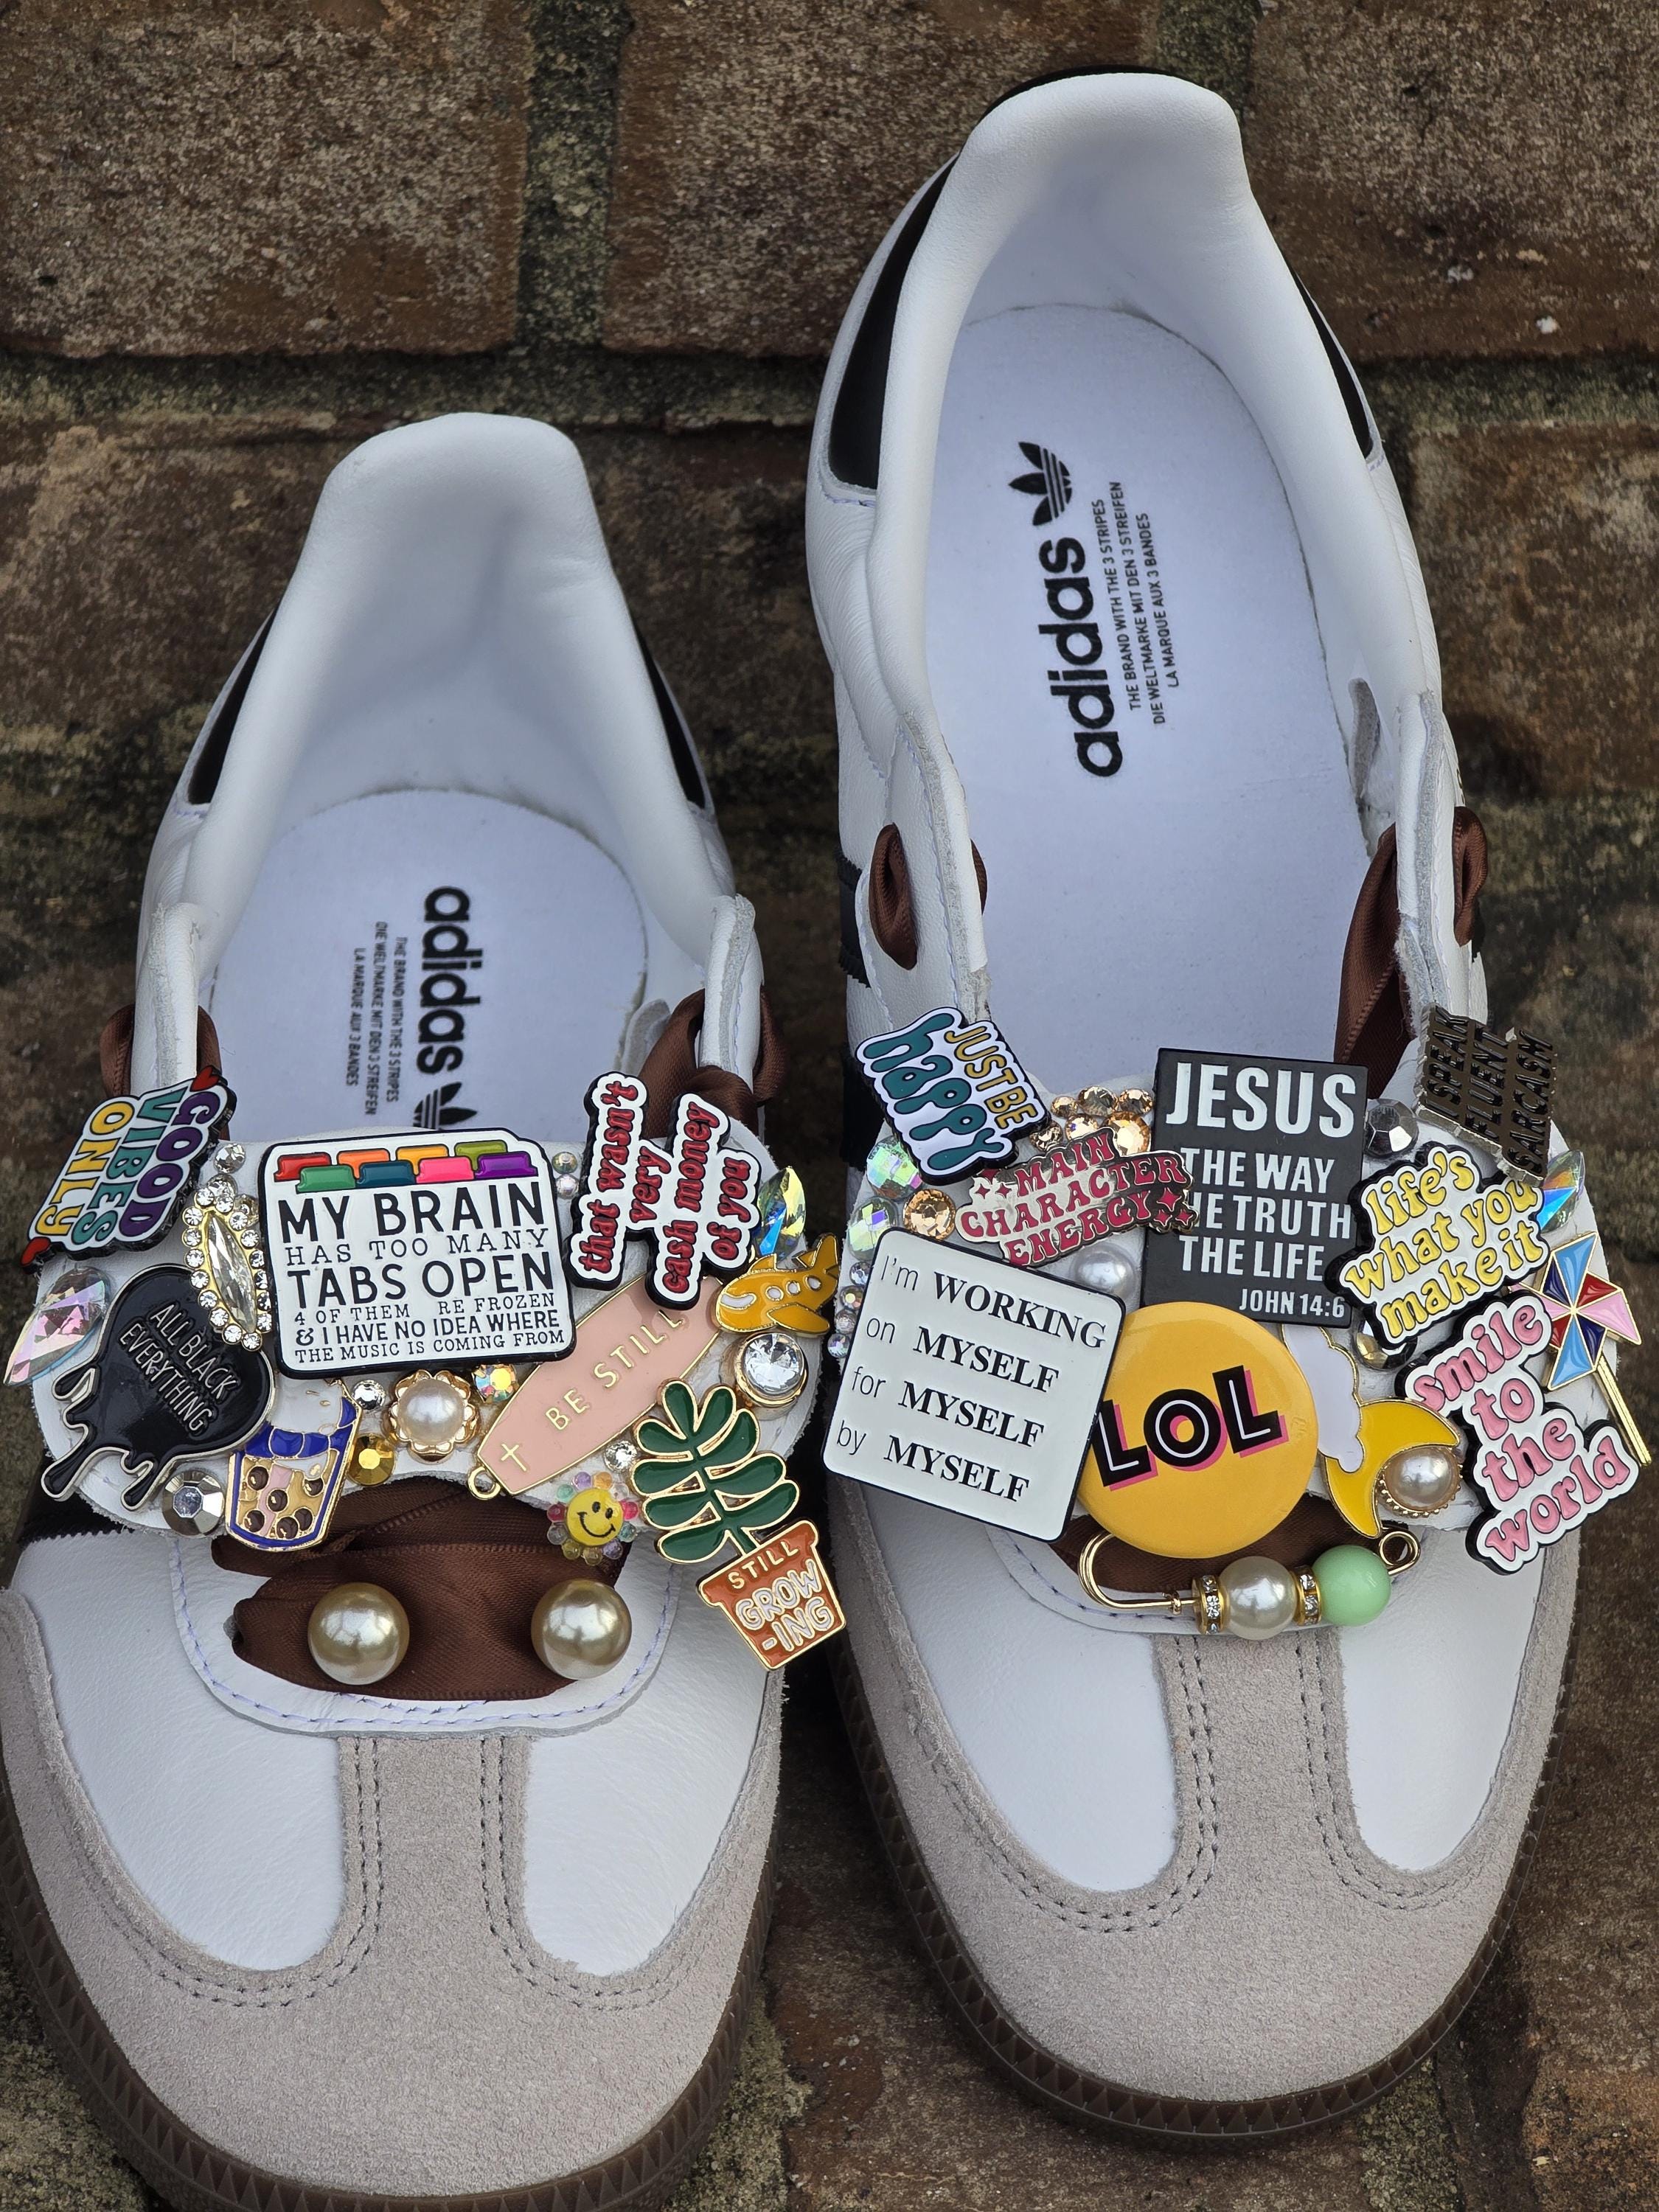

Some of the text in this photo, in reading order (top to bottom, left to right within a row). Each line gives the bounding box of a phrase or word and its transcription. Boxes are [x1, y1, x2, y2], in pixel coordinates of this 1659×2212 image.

[1091, 499, 1113, 553] STRIPES
[1109, 481, 1132, 545] STREIFEN
[1135, 513, 1157, 566] BANDES
[1104, 568, 1120, 594] THE
[1124, 559, 1140, 587] DEN
[1129, 591, 1145, 613] MIT
[1148, 580, 1164, 607] AUX
[1110, 597, 1127, 631] WITH
[1154, 611, 1175, 667] MARQUE
[1038, 538, 1122, 776] adidas
[1117, 633, 1137, 680] BRAND
[1135, 617, 1161, 700] WELTMARKE
[1166, 670, 1179, 687] LA
[1126, 684, 1141, 711] THE
[1150, 702, 1165, 724] DIE
[392, 959, 406, 998] BRAND
[416, 886, 483, 1075] adidas
[863, 1012, 1005, 1171] happy
[944, 1026, 1037, 1129] JUST BE
[1427, 1006, 1470, 1105] SPEAK
[1464, 1023, 1509, 1141] FLUENT
[1166, 1061, 1356, 1138] JESUS
[1507, 1029, 1554, 1173] SARCASM
[73, 1086, 189, 1245] VIBES
[118, 1091, 222, 1237] GOOD
[580, 1081, 639, 1273] that wasn't
[629, 1146, 672, 1222] very
[663, 1102, 720, 1293] cash money
[959, 1154, 1188, 1238] CHARACTER
[1015, 1131, 1116, 1198] MAIN
[1180, 1147, 1335, 1193] THE WAY
[1366, 1152, 1475, 1235] life's
[278, 1181, 545, 1243] MY BRAIN
[706, 1157, 751, 1259] of you
[1004, 1189, 1152, 1267] ENERGY
[1188, 1192, 1352, 1239] HE TRUTH
[1344, 1180, 1538, 1298] what you
[285, 1228, 549, 1266] HAS TOO MANY
[287, 1251, 554, 1309] TABS OPEN
[1179, 1235, 1325, 1282] THE LIFE
[1380, 1222, 1544, 1338] make it
[294, 1293, 555, 1325] 4 OF THEM RE FROZEN
[296, 1310, 560, 1346] & I HAVE NO IDEA WHERE
[880, 1255, 1107, 1349] I'm WORKING
[1239, 1287, 1346, 1318] JOHN 14:6
[119, 1323, 212, 1431] EVERYTHING
[150, 1304, 237, 1399] ALL BLACK
[294, 1329, 565, 1363] THE MUSIC IS COMING FROM
[544, 1309, 685, 1431] BE STILL
[866, 1316, 1060, 1394] on MYSELF
[1413, 1304, 1544, 1412] smile
[851, 1366, 1045, 1449] for MYSELF
[1091, 1364, 1290, 1492] LOL
[1470, 1377, 1535, 1441] to
[836, 1419, 1030, 1503] by MYSELF
[1481, 1418, 1576, 1502] the
[1485, 1434, 1631, 1562] world
[729, 1540, 799, 1590] STILL
[736, 1559, 821, 1632] GROW
[762, 1597, 835, 1653] -ING
